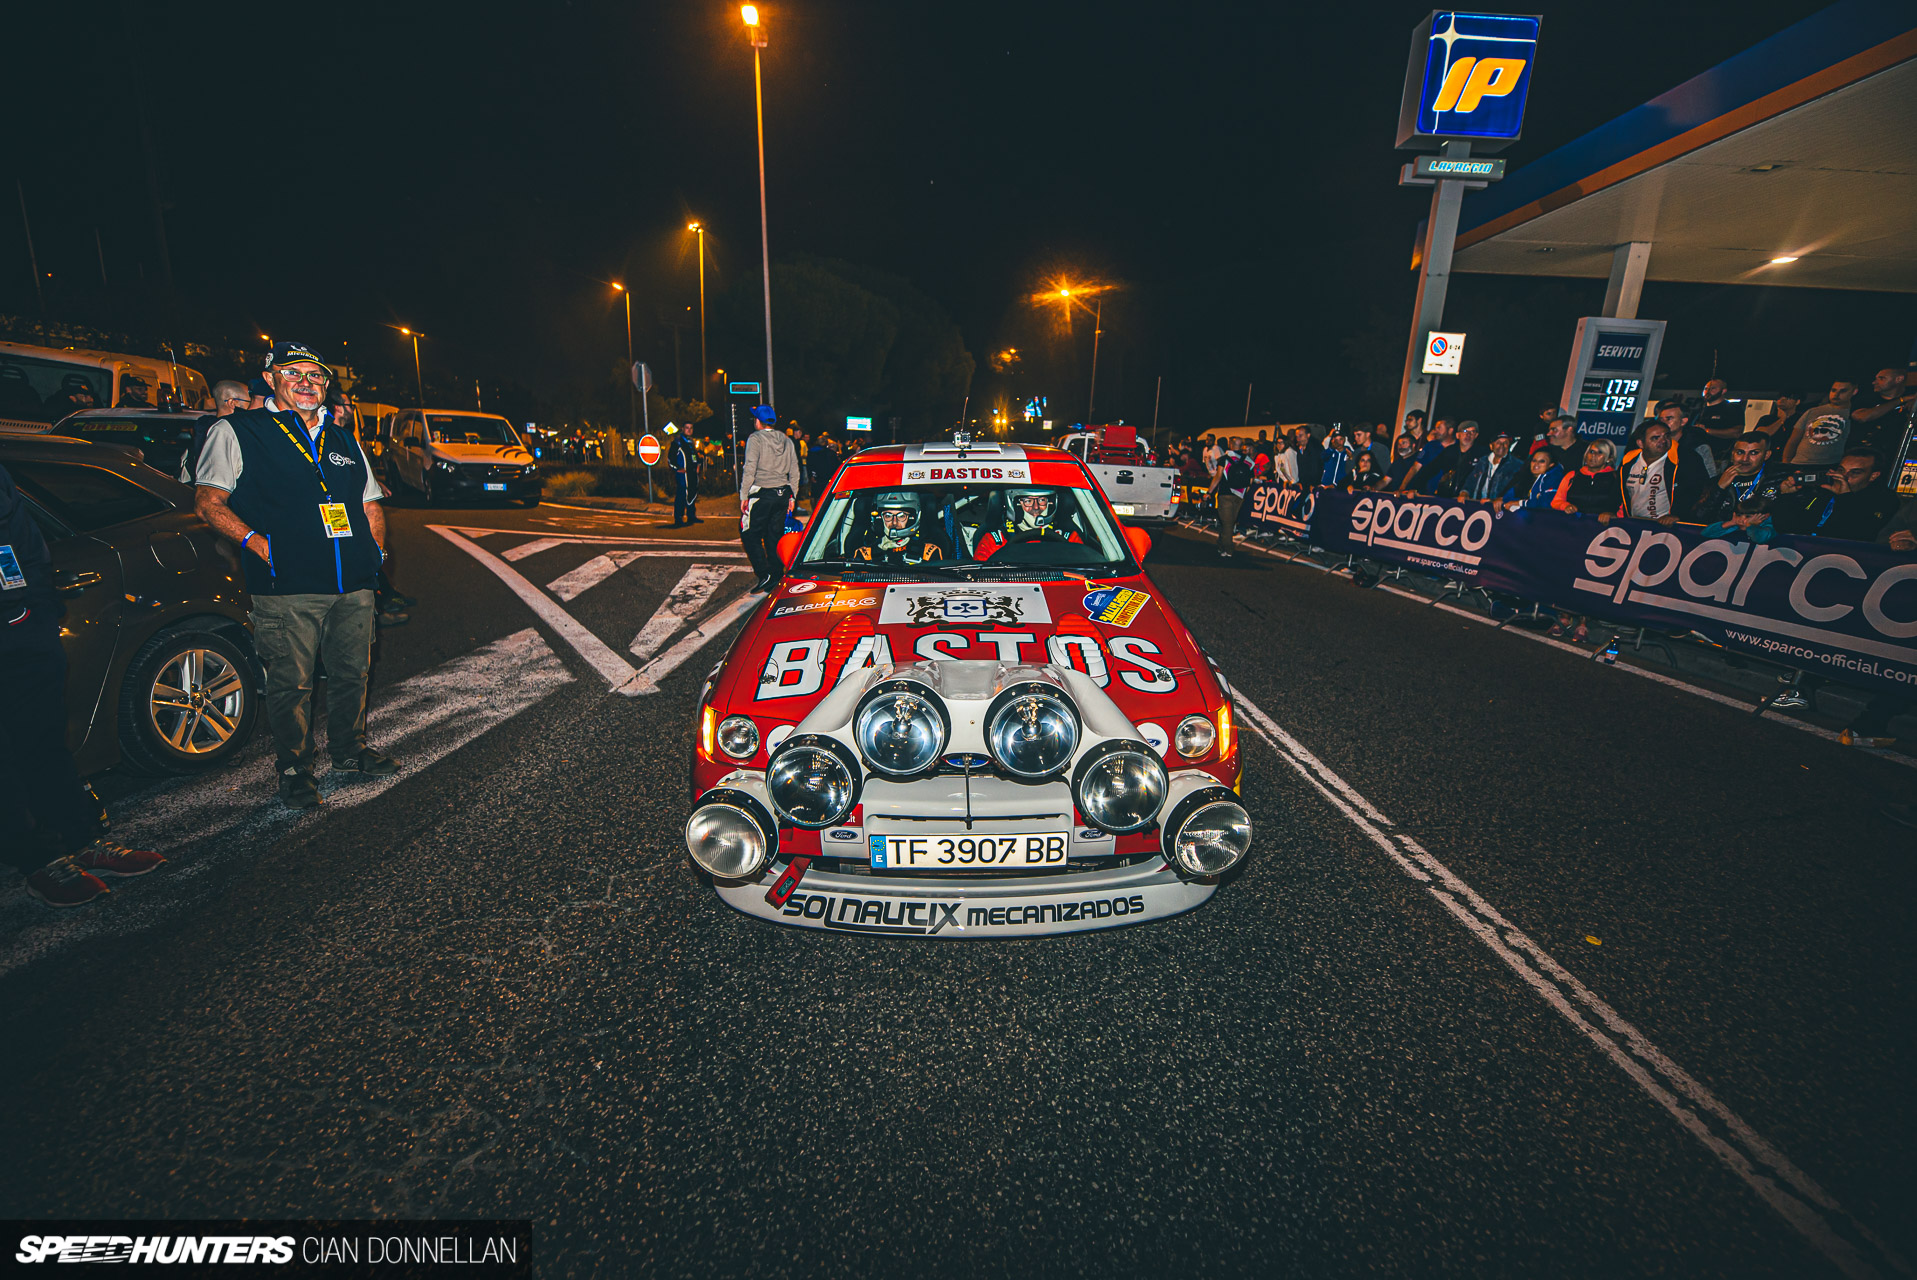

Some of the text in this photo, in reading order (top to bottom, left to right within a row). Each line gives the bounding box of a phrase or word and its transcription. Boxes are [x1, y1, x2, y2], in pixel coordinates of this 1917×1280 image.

[1432, 56, 1527, 114] IP
[1428, 161, 1494, 174] LAVAGGIO
[1597, 345, 1643, 359] SERVITO
[1577, 421, 1627, 436] AdBlue
[930, 468, 1003, 480] BASTOS
[1253, 486, 1315, 522] sparo
[1351, 497, 1493, 552] sparco
[1584, 526, 1917, 638] sparco
[835, 830, 853, 840] Ford
[875, 854, 884, 863] E
[888, 837, 1065, 865] TF 3907 BB
[783, 893, 1145, 935] SOLNAUTIX MECANIZADOS
